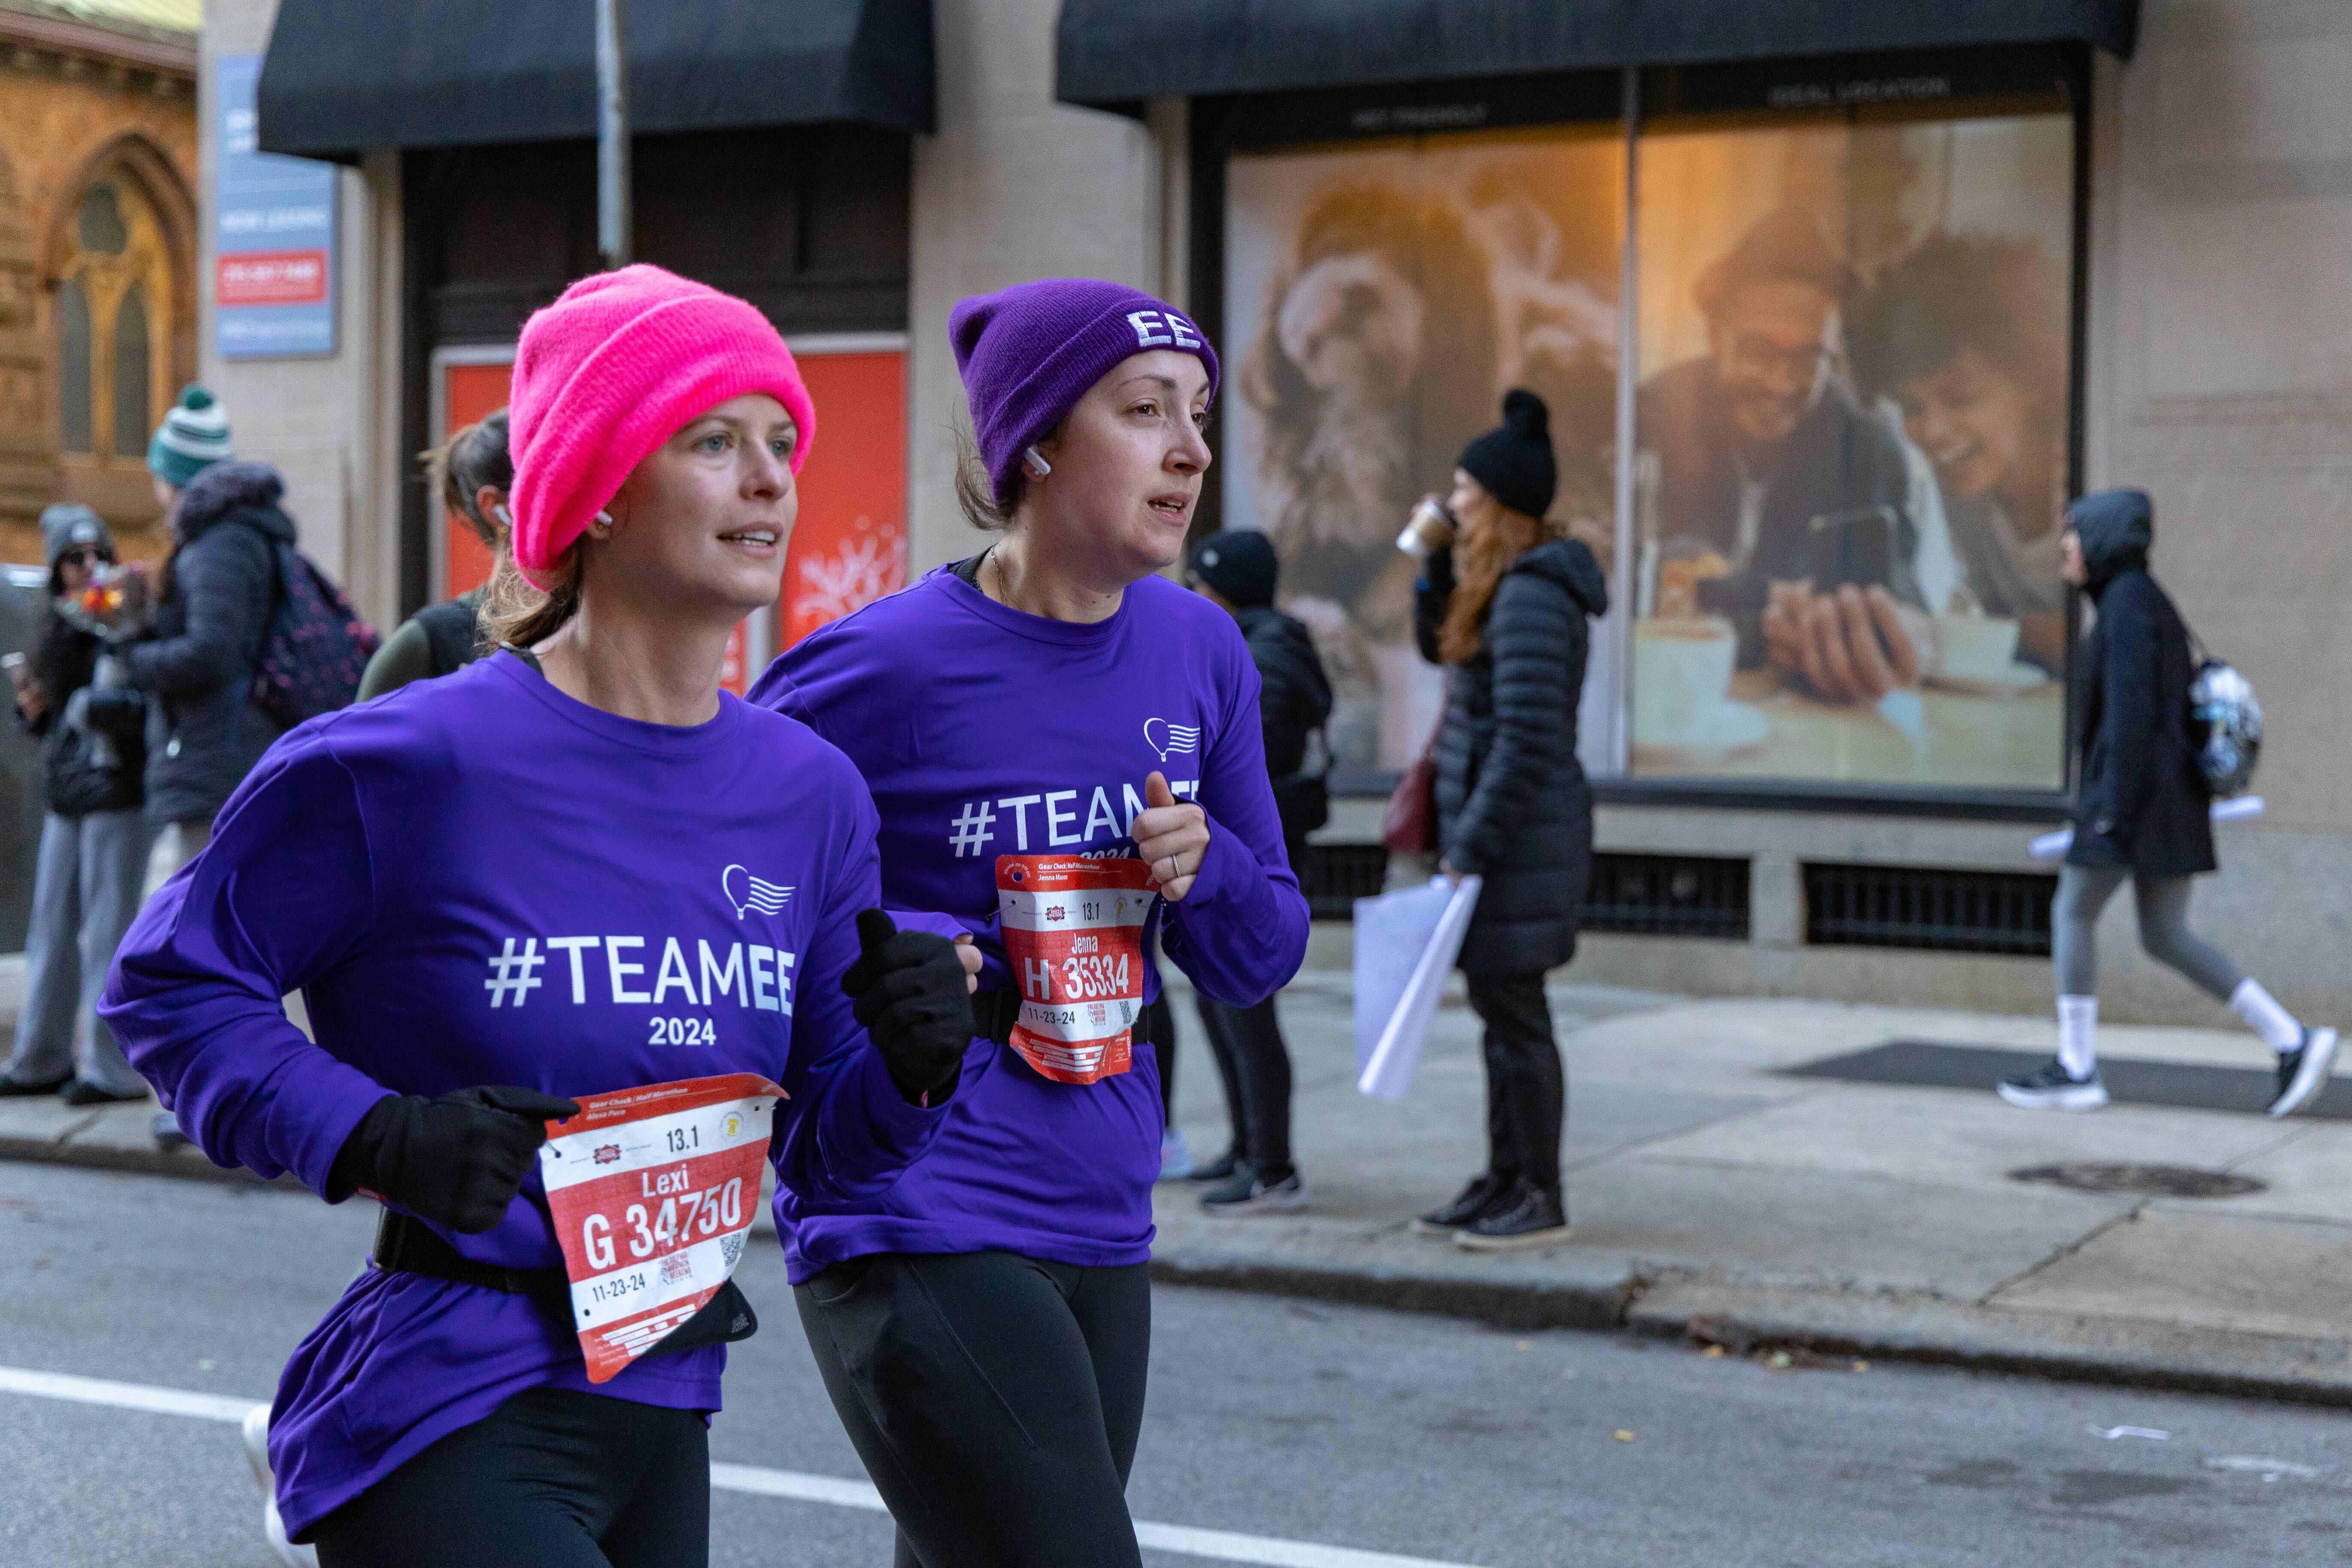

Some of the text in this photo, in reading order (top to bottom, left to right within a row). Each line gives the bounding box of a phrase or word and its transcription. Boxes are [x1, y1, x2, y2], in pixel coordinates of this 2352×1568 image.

[1126, 311, 1200, 349] EE
[1083, 902, 1099, 921] 13.1
[1072, 933, 1098, 954] Jenna
[485, 935, 795, 1017] #TEAMEE
[1025, 953, 1129, 1000] H 35334
[648, 1016, 717, 1046] 2024
[1029, 1007, 1075, 1025] 11-23-24
[667, 1125, 700, 1153] 13.1
[642, 1164, 691, 1198] Lexi
[583, 1176, 743, 1270] G 34750
[592, 1272, 646, 1302] 11-23-24
